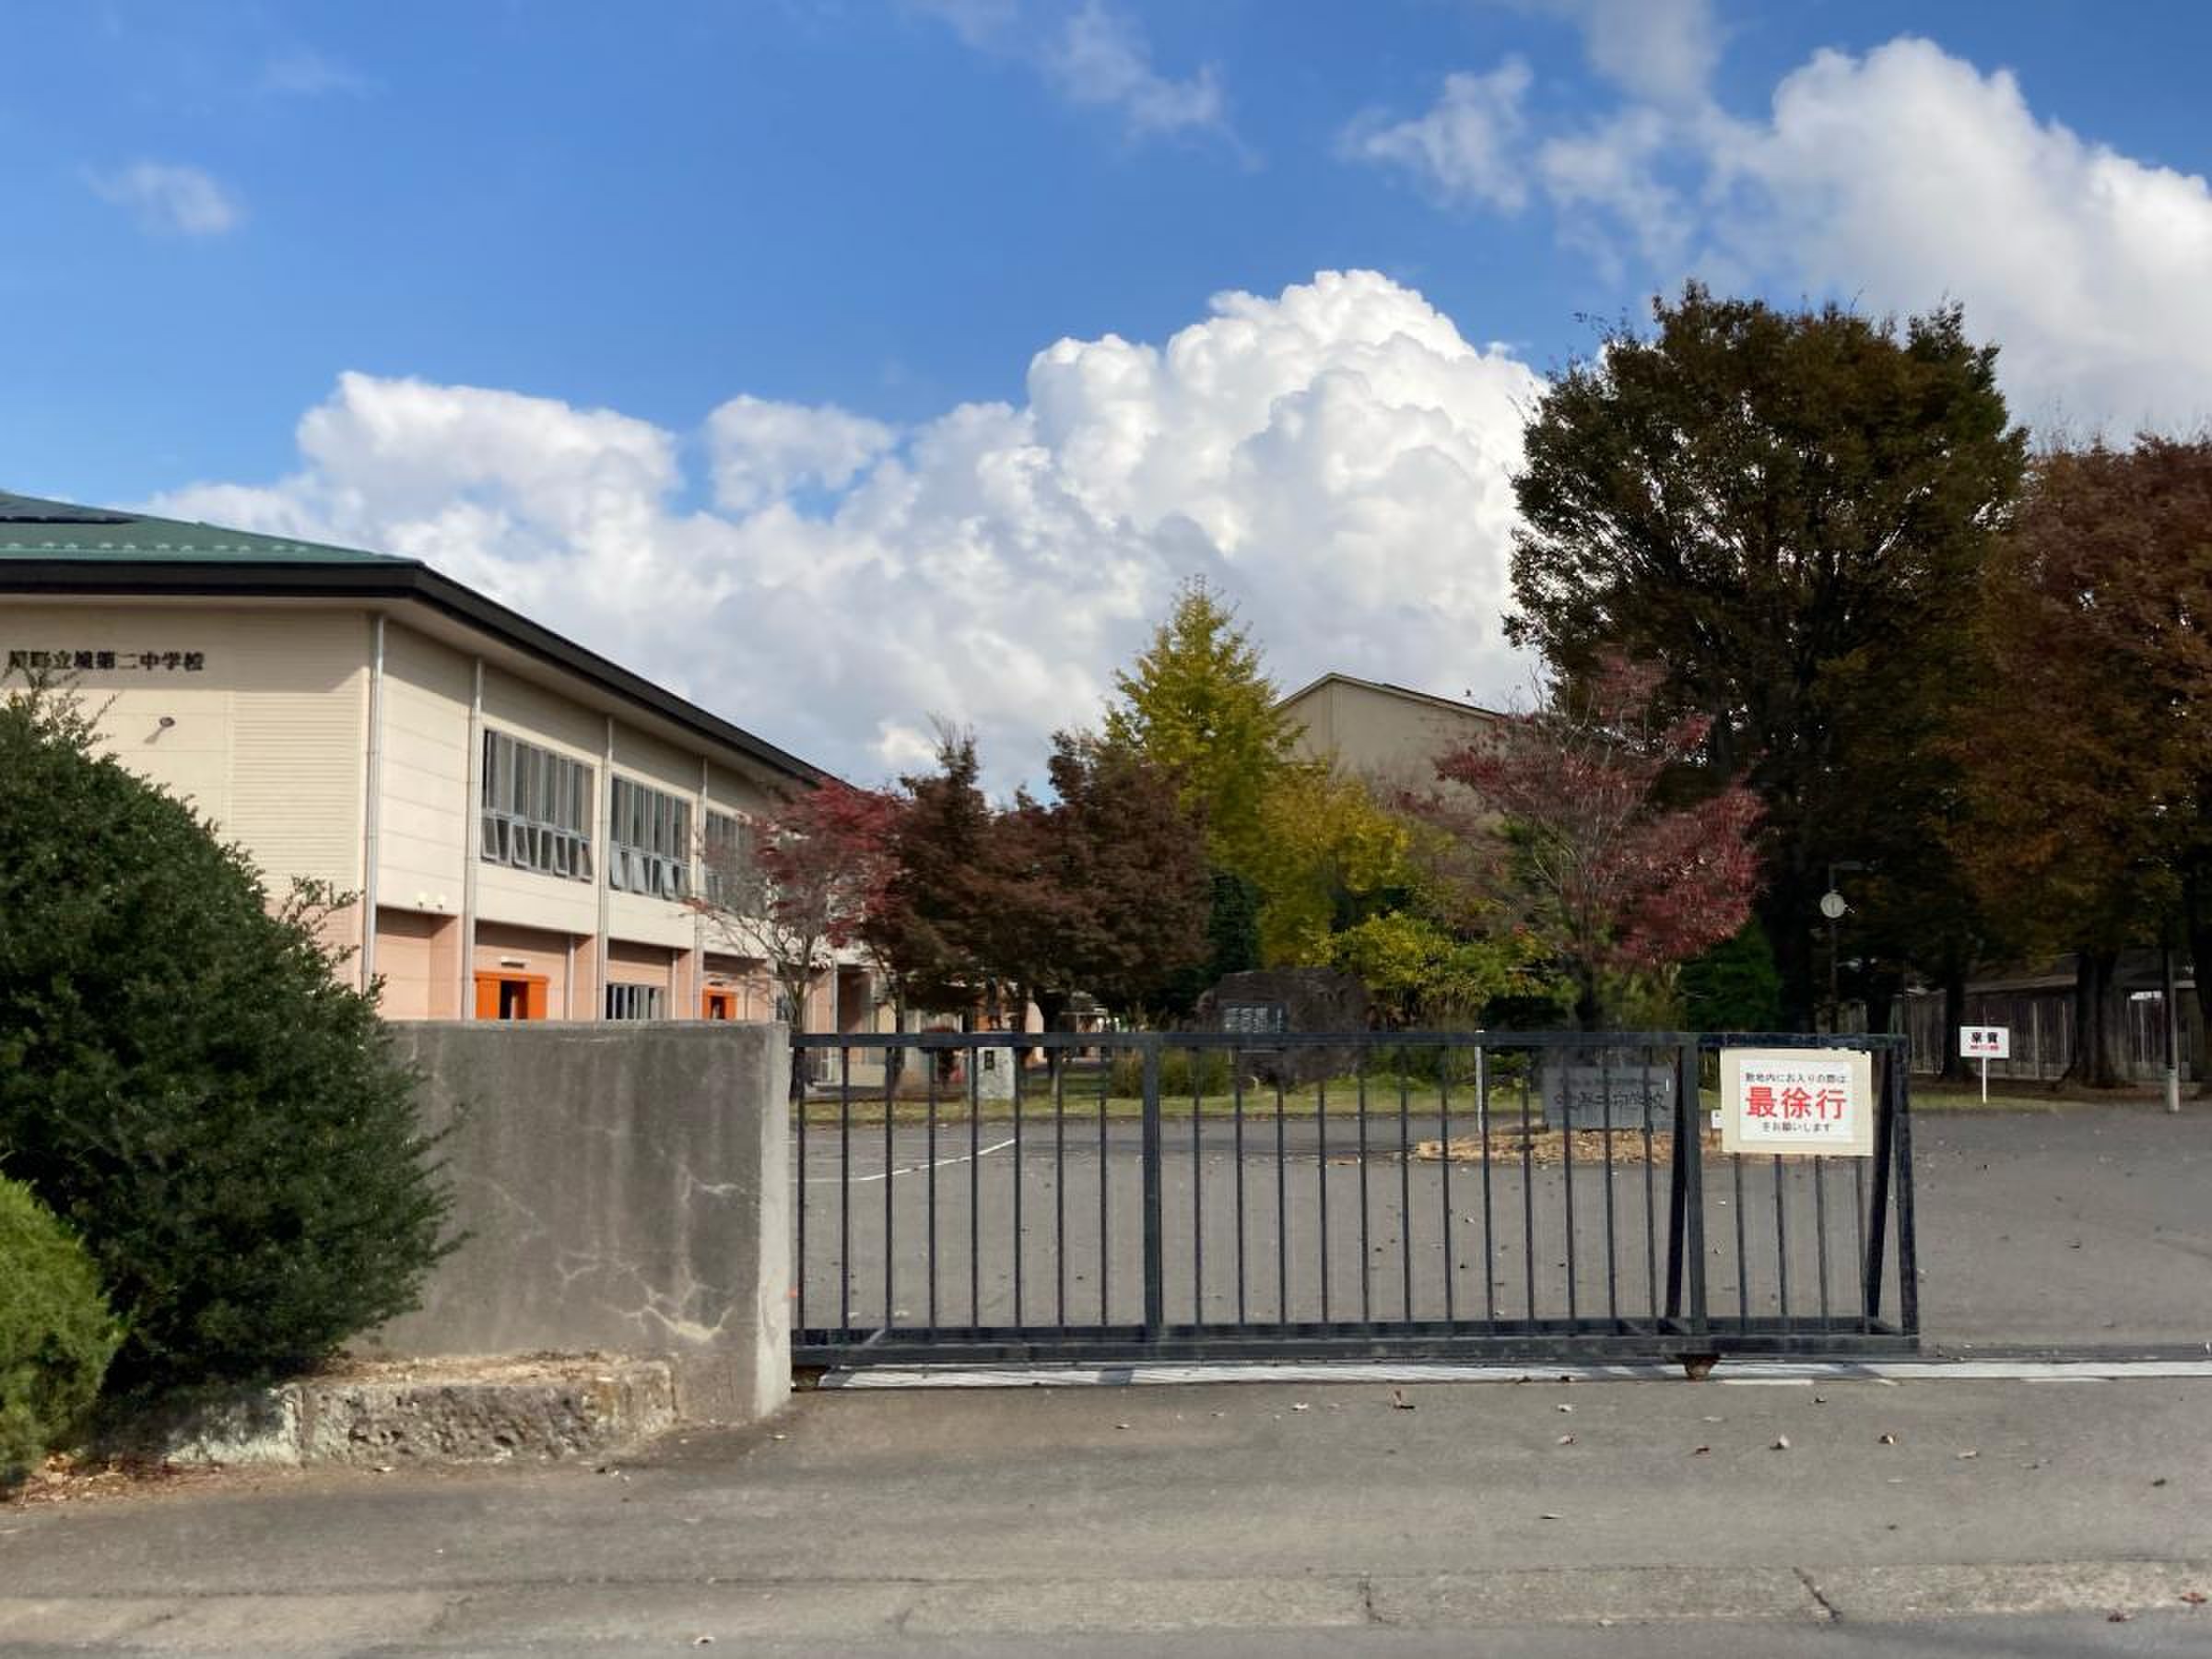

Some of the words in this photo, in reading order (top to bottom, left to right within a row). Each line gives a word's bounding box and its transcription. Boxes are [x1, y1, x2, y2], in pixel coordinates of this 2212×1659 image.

[1746, 1086, 1848, 1121] 最徐行
[1761, 1122, 1830, 1133] をお願いします
